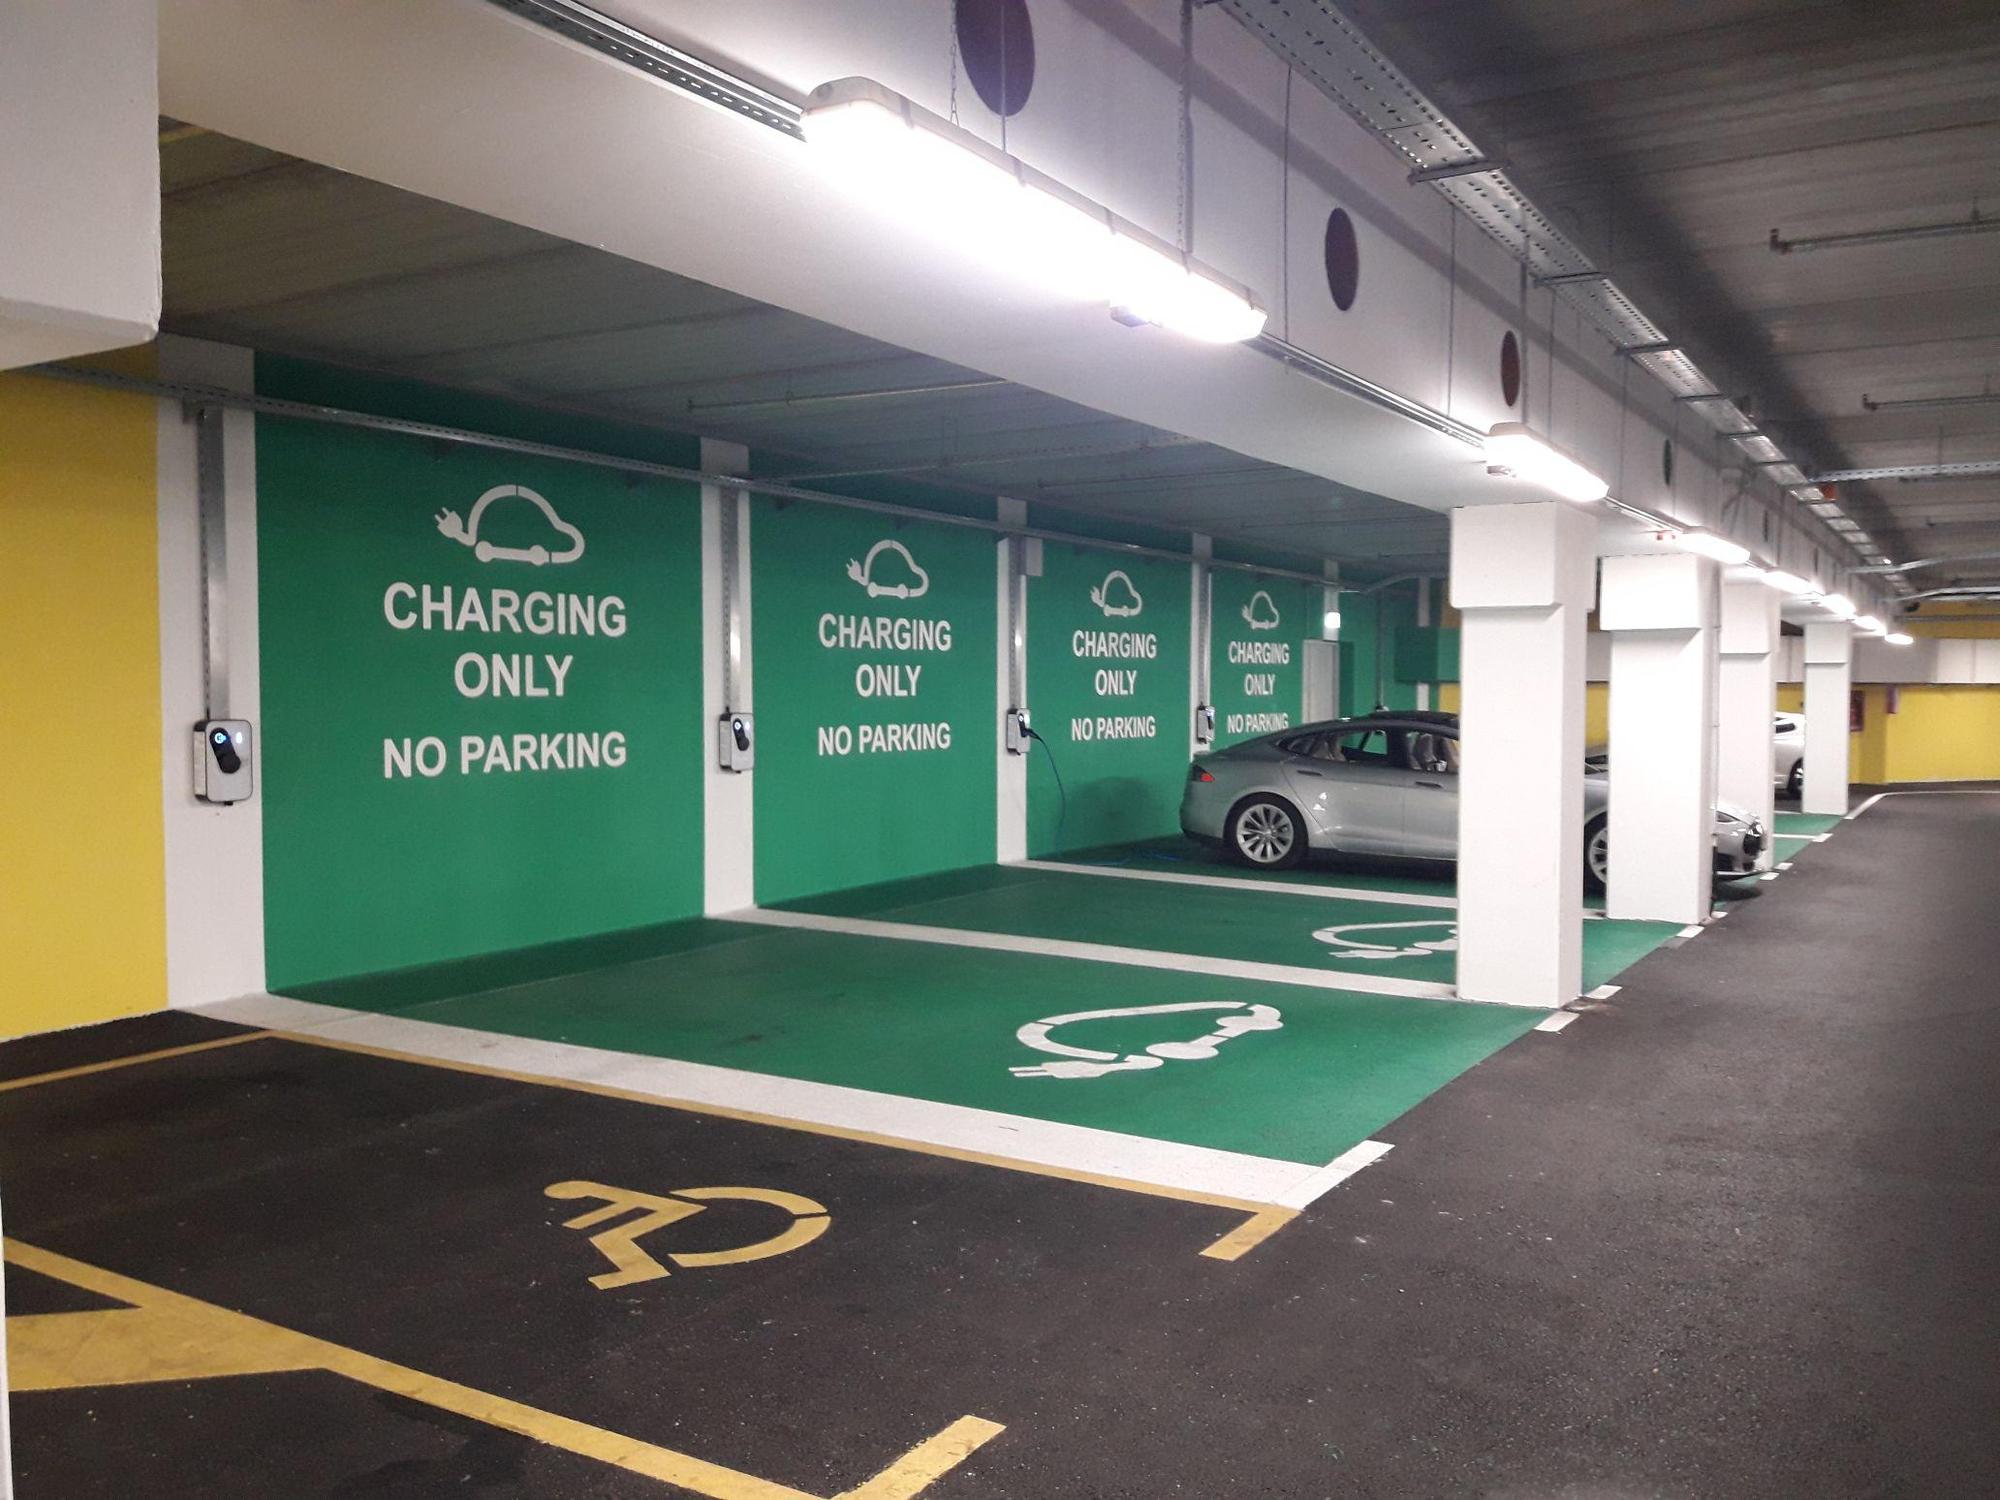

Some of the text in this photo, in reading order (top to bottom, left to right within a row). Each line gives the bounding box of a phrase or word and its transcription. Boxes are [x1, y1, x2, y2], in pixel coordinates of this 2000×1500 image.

[383, 582, 627, 638] CHARGING
[818, 613, 952, 652] CHARGING
[1072, 629, 1157, 659] CHARGING
[1228, 640, 1290, 665] CHARGING
[454, 652, 574, 698] ONLY
[855, 663, 922, 698] ONLY
[1094, 669, 1137, 696] ONLY
[1244, 673, 1276, 696] ONLY
[818, 722, 951, 756] NO PARKING
[1071, 715, 1156, 741] NO PARKING
[1227, 712, 1289, 734] NO PARKING
[383, 731, 627, 779] NO PARKING
